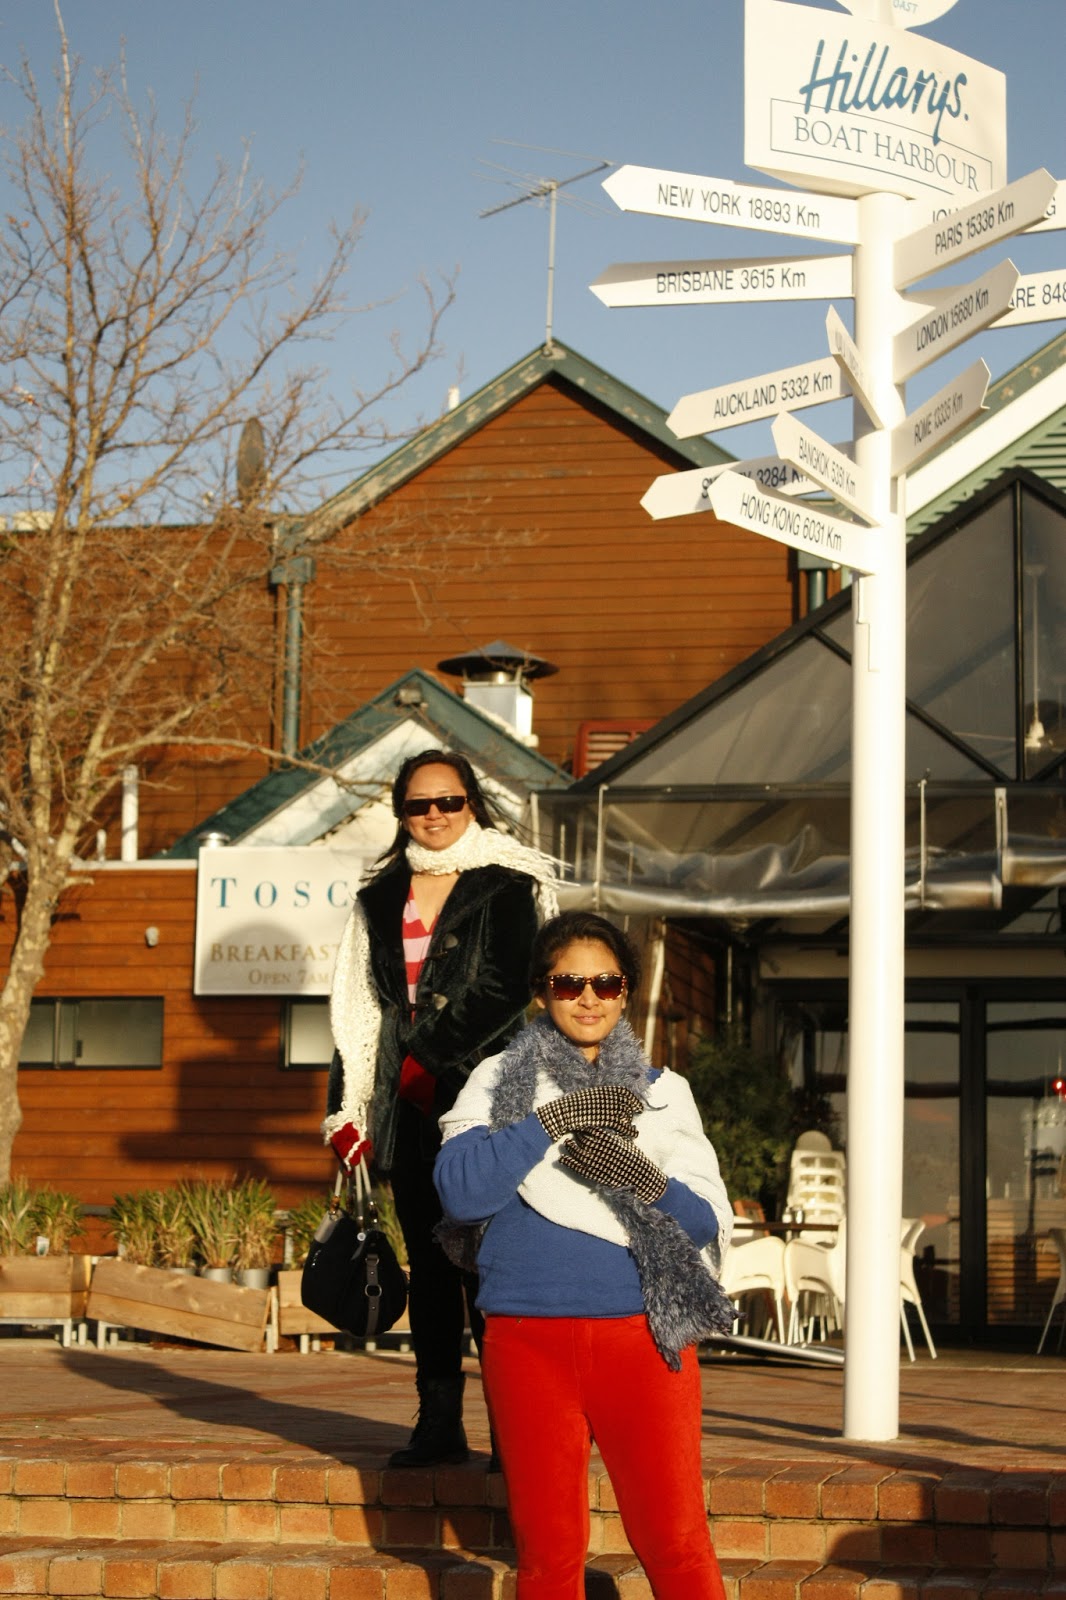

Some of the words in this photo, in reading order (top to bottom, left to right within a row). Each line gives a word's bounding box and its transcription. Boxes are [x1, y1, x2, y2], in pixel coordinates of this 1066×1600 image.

[893, 0, 918, 14] OAST
[793, 116, 868, 153] BOAT
[874, 133, 980, 192] HARBOUR
[657, 183, 694, 208] NEW
[701, 190, 741, 216] YORK
[748, 199, 791, 223] 18893
[796, 206, 820, 228] Km
[935, 223, 962, 255] PARIS
[966, 207, 995, 239] 15336
[997, 201, 1014, 225] Km
[656, 270, 734, 293] BRISBANE
[740, 268, 775, 289] 3615
[781, 267, 806, 288] Km
[916, 315, 948, 351] LONDON
[975, 288, 989, 313] Km
[714, 384, 776, 419] AUCKLAND
[781, 376, 809, 402] 5332
[813, 371, 832, 393] Km
[757, 465, 787, 488] 3284
[799, 436, 829, 480] BANGKOK
[740, 493, 770, 525] HONG
[772, 505, 800, 537] KONG
[803, 518, 825, 545] 6031
[826, 526, 842, 552] Km
